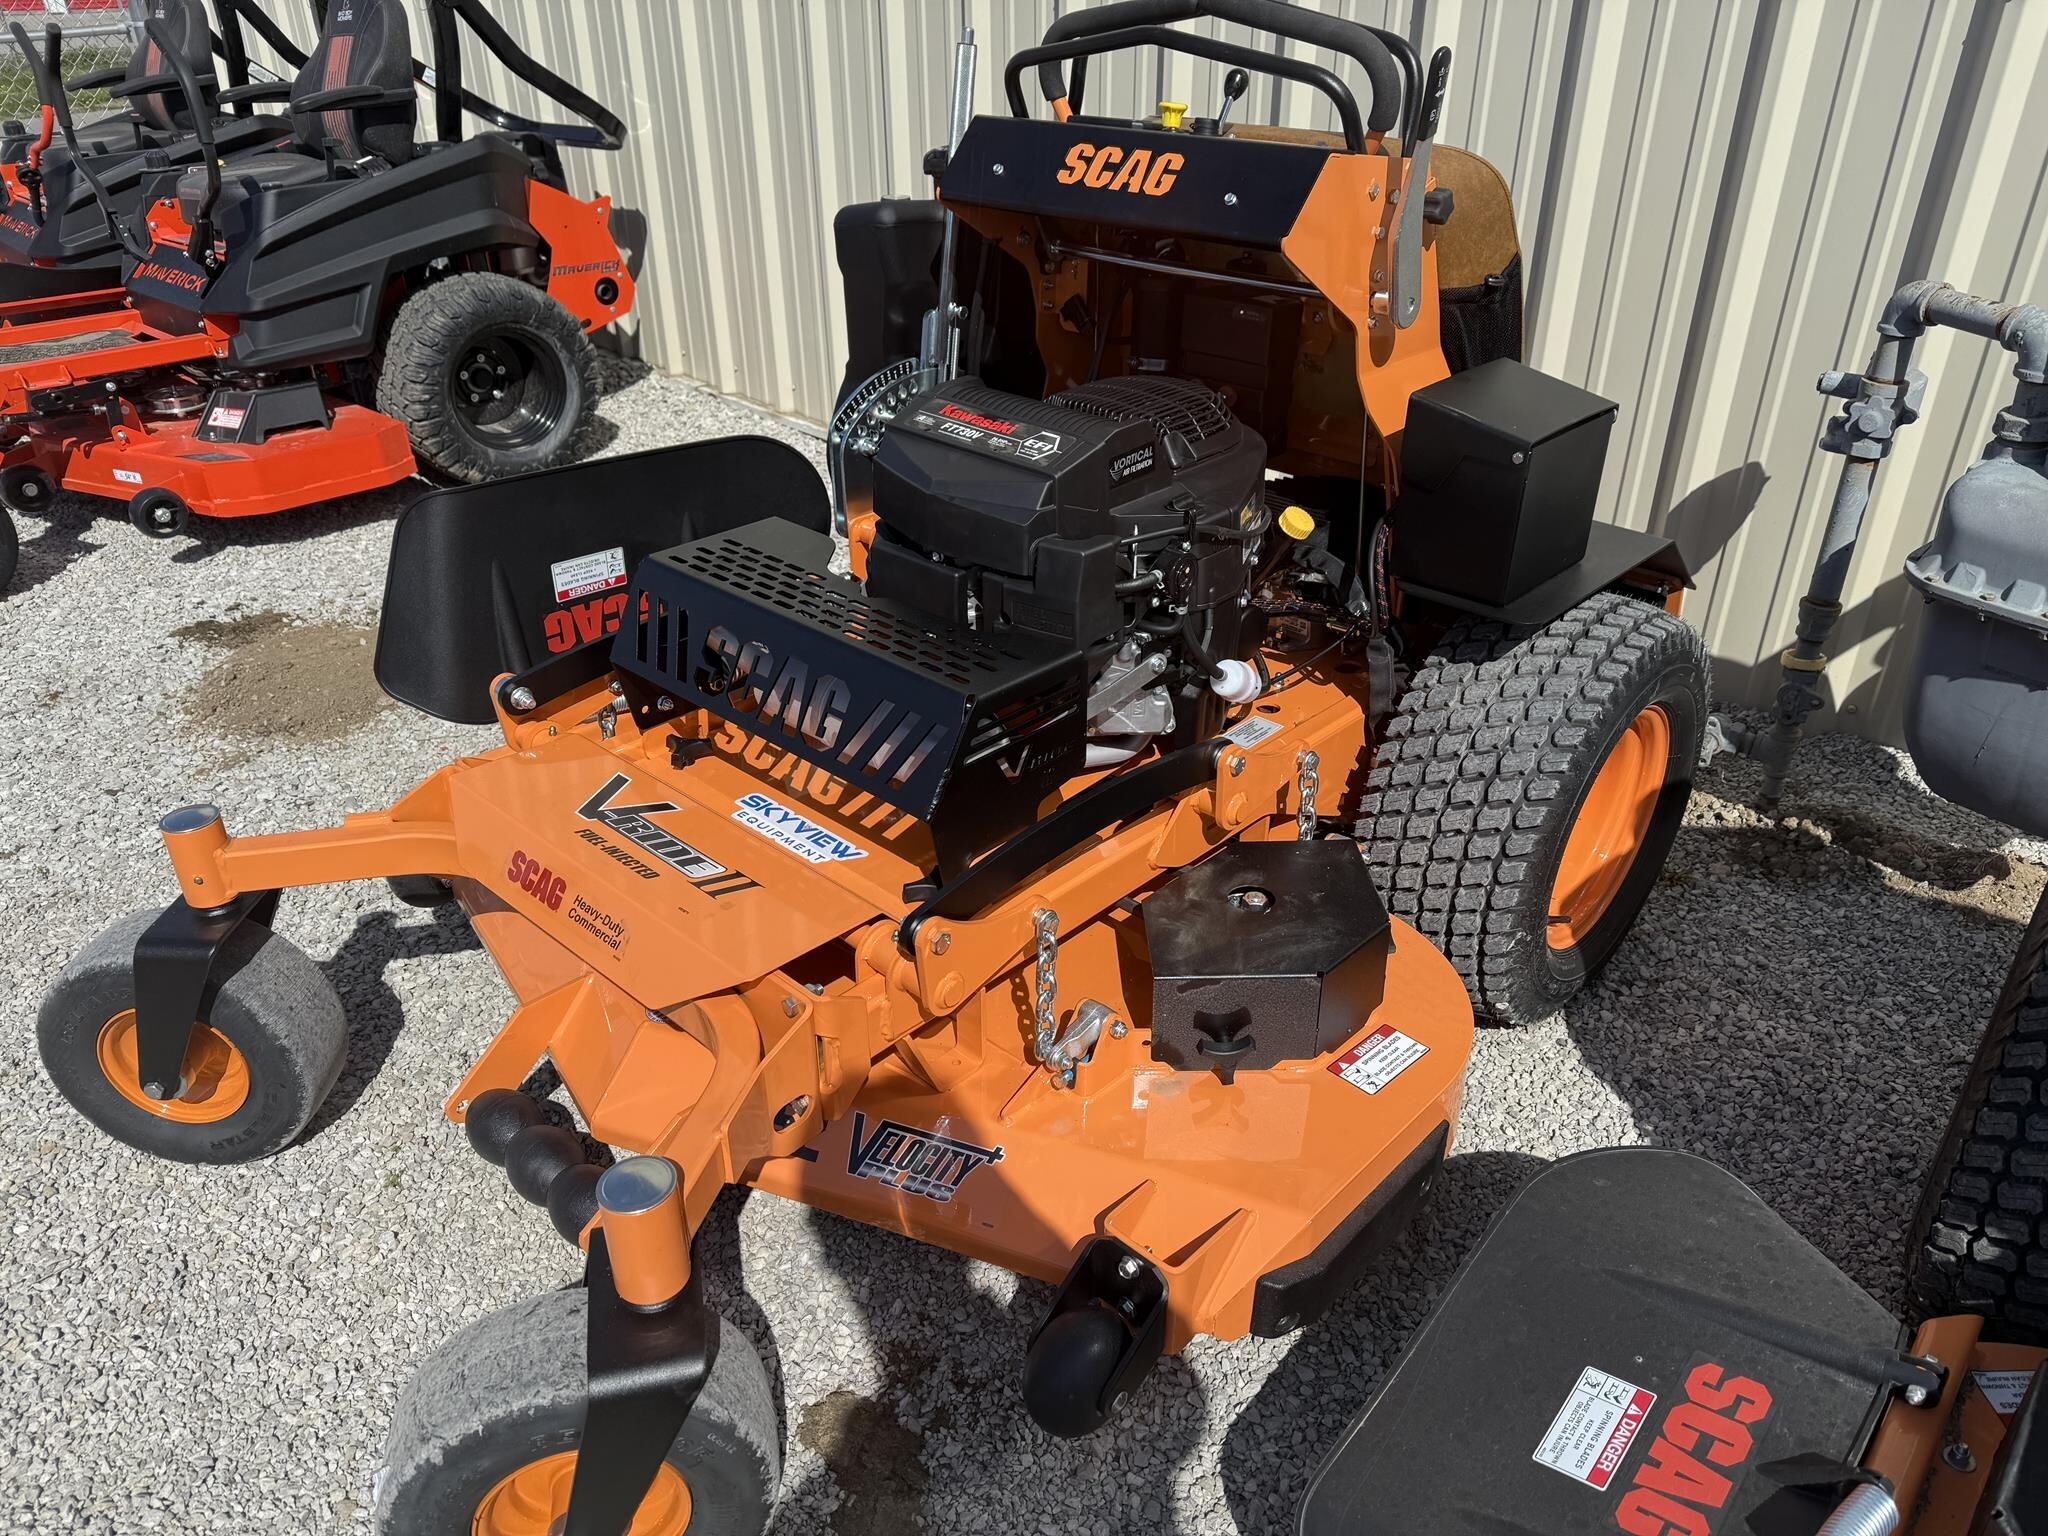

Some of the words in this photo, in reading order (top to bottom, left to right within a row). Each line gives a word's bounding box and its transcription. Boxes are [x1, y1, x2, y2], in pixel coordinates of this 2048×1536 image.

[1056, 143, 1185, 196] SCAG
[143, 263, 207, 292] MAVERICK
[939, 404, 1020, 435] Kawasaki
[940, 422, 984, 439] FT730V
[1023, 438, 1053, 452] EFI
[1113, 446, 1153, 470] VORTICAL
[1122, 467, 1131, 477] AIR
[568, 581, 606, 597] DANGER
[694, 626, 851, 752] SCAG
[737, 811, 826, 861] EQUIPMENT
[740, 795, 862, 858] SKYVIEW
[574, 828, 660, 880] FUEL-INJECTED
[507, 850, 567, 912] SCAG
[572, 894, 625, 938] Heavy-Duty
[567, 907, 622, 951] Commercial
[1353, 1033, 1386, 1057] DANGER
[1361, 1049, 1384, 1066] SPINNING
[1382, 1035, 1401, 1050] BLADES
[1379, 1054, 1389, 1064] KEEP
[1387, 1046, 1400, 1058] CLEAR
[1374, 1066, 1387, 1076] BLADE
[1386, 1055, 1401, 1071] CONTACT
[1399, 1057, 1409, 1067] CAN
[857, 1162, 955, 1203] PLUS
[1568, 1401, 1584, 1423] OBJECTS
[1583, 1396, 1595, 1414] BLADE
[1560, 1422, 1571, 1435] CAN
[1571, 1413, 1586, 1437] CONTACT
[1583, 1419, 1594, 1435] KEEP
[1591, 1410, 1614, 1443] SPINNING
[1549, 1434, 1564, 1454] INJURE
[1552, 1441, 1569, 1464] THROWN
[1573, 1431, 1587, 1450] CLEAR
[1597, 1418, 1637, 1472] DANGER
[1575, 1443, 1595, 1470] BLADES
